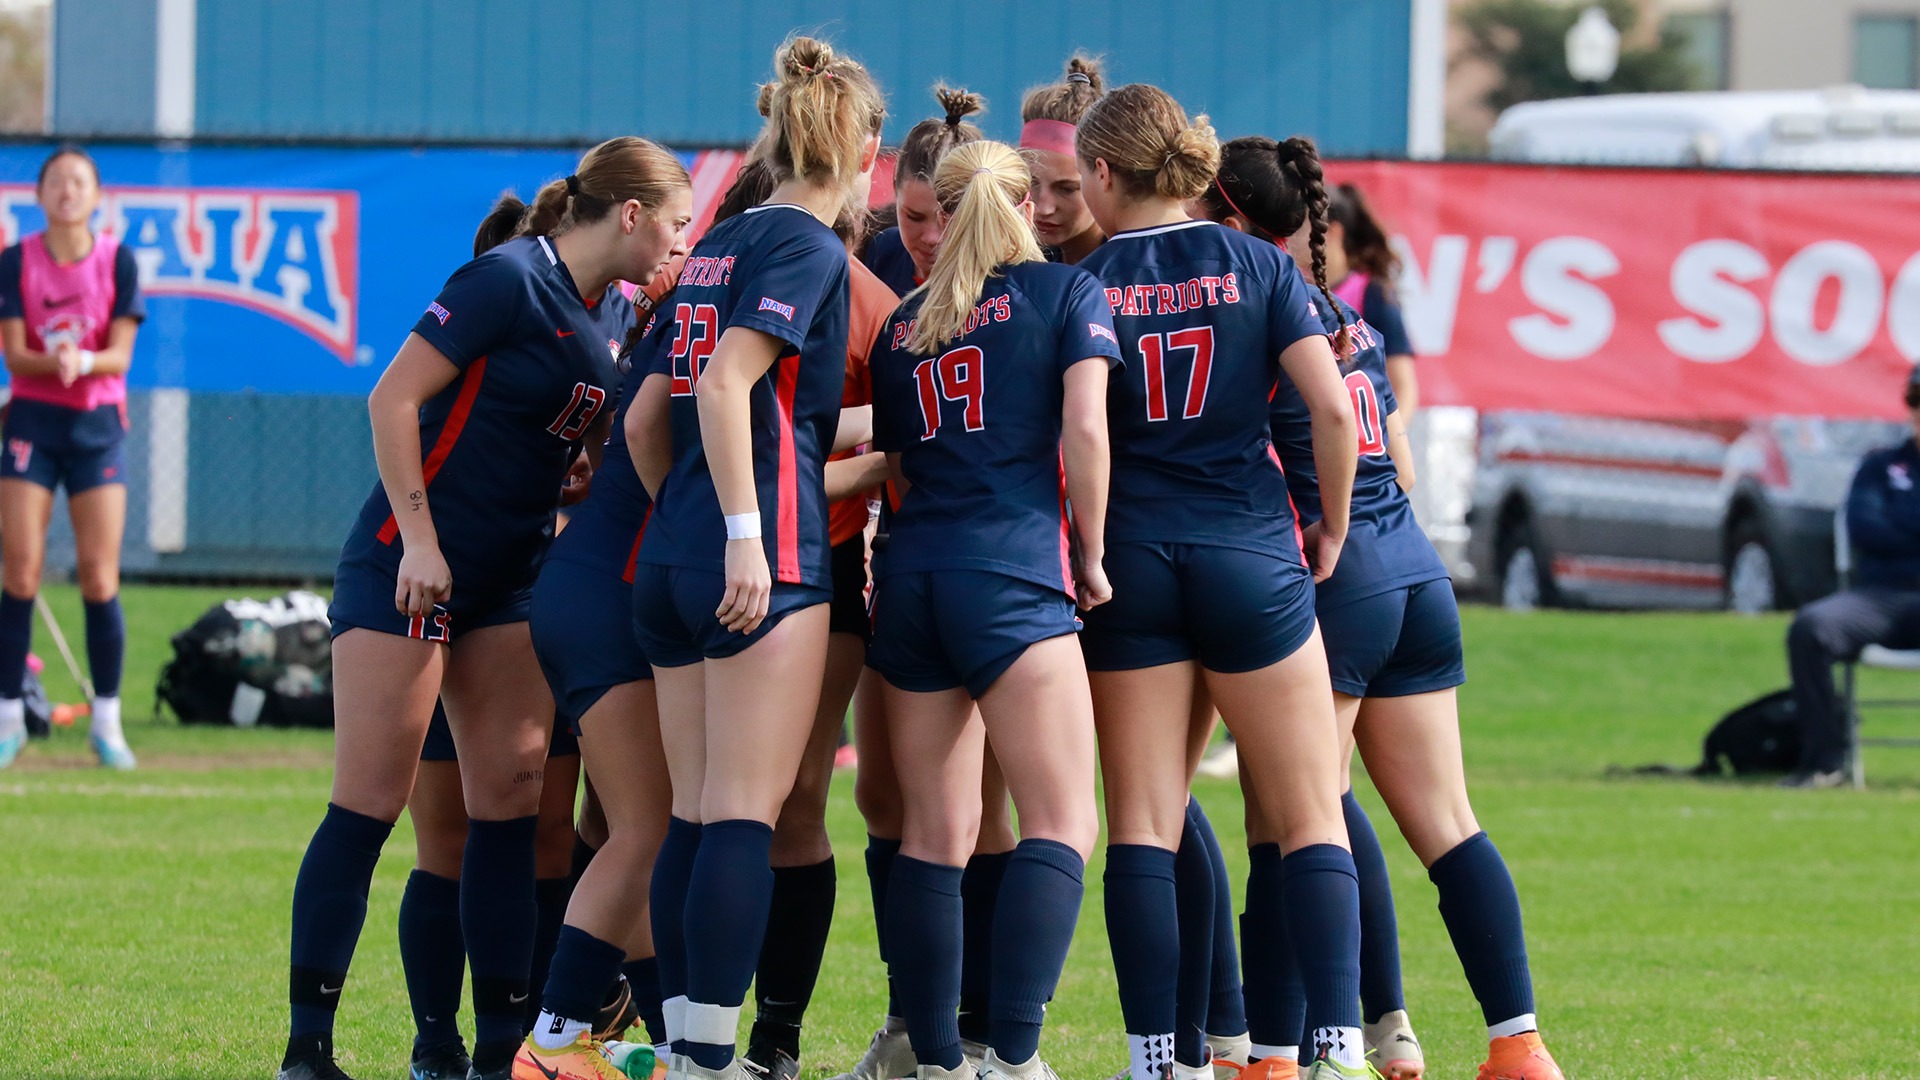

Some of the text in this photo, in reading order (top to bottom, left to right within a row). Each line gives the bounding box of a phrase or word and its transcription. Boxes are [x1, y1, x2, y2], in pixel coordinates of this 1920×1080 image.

[759, 297, 794, 321] NAIA
[891, 293, 1012, 351] POTS
[1104, 272, 1240, 316] PATRIOTS
[1656, 238, 1920, 366] SO
[671, 303, 718, 397] 22
[1138, 325, 1214, 422] 17
[546, 382, 606, 440] 13
[913, 345, 985, 441] 19
[408, 604, 452, 642] 13
